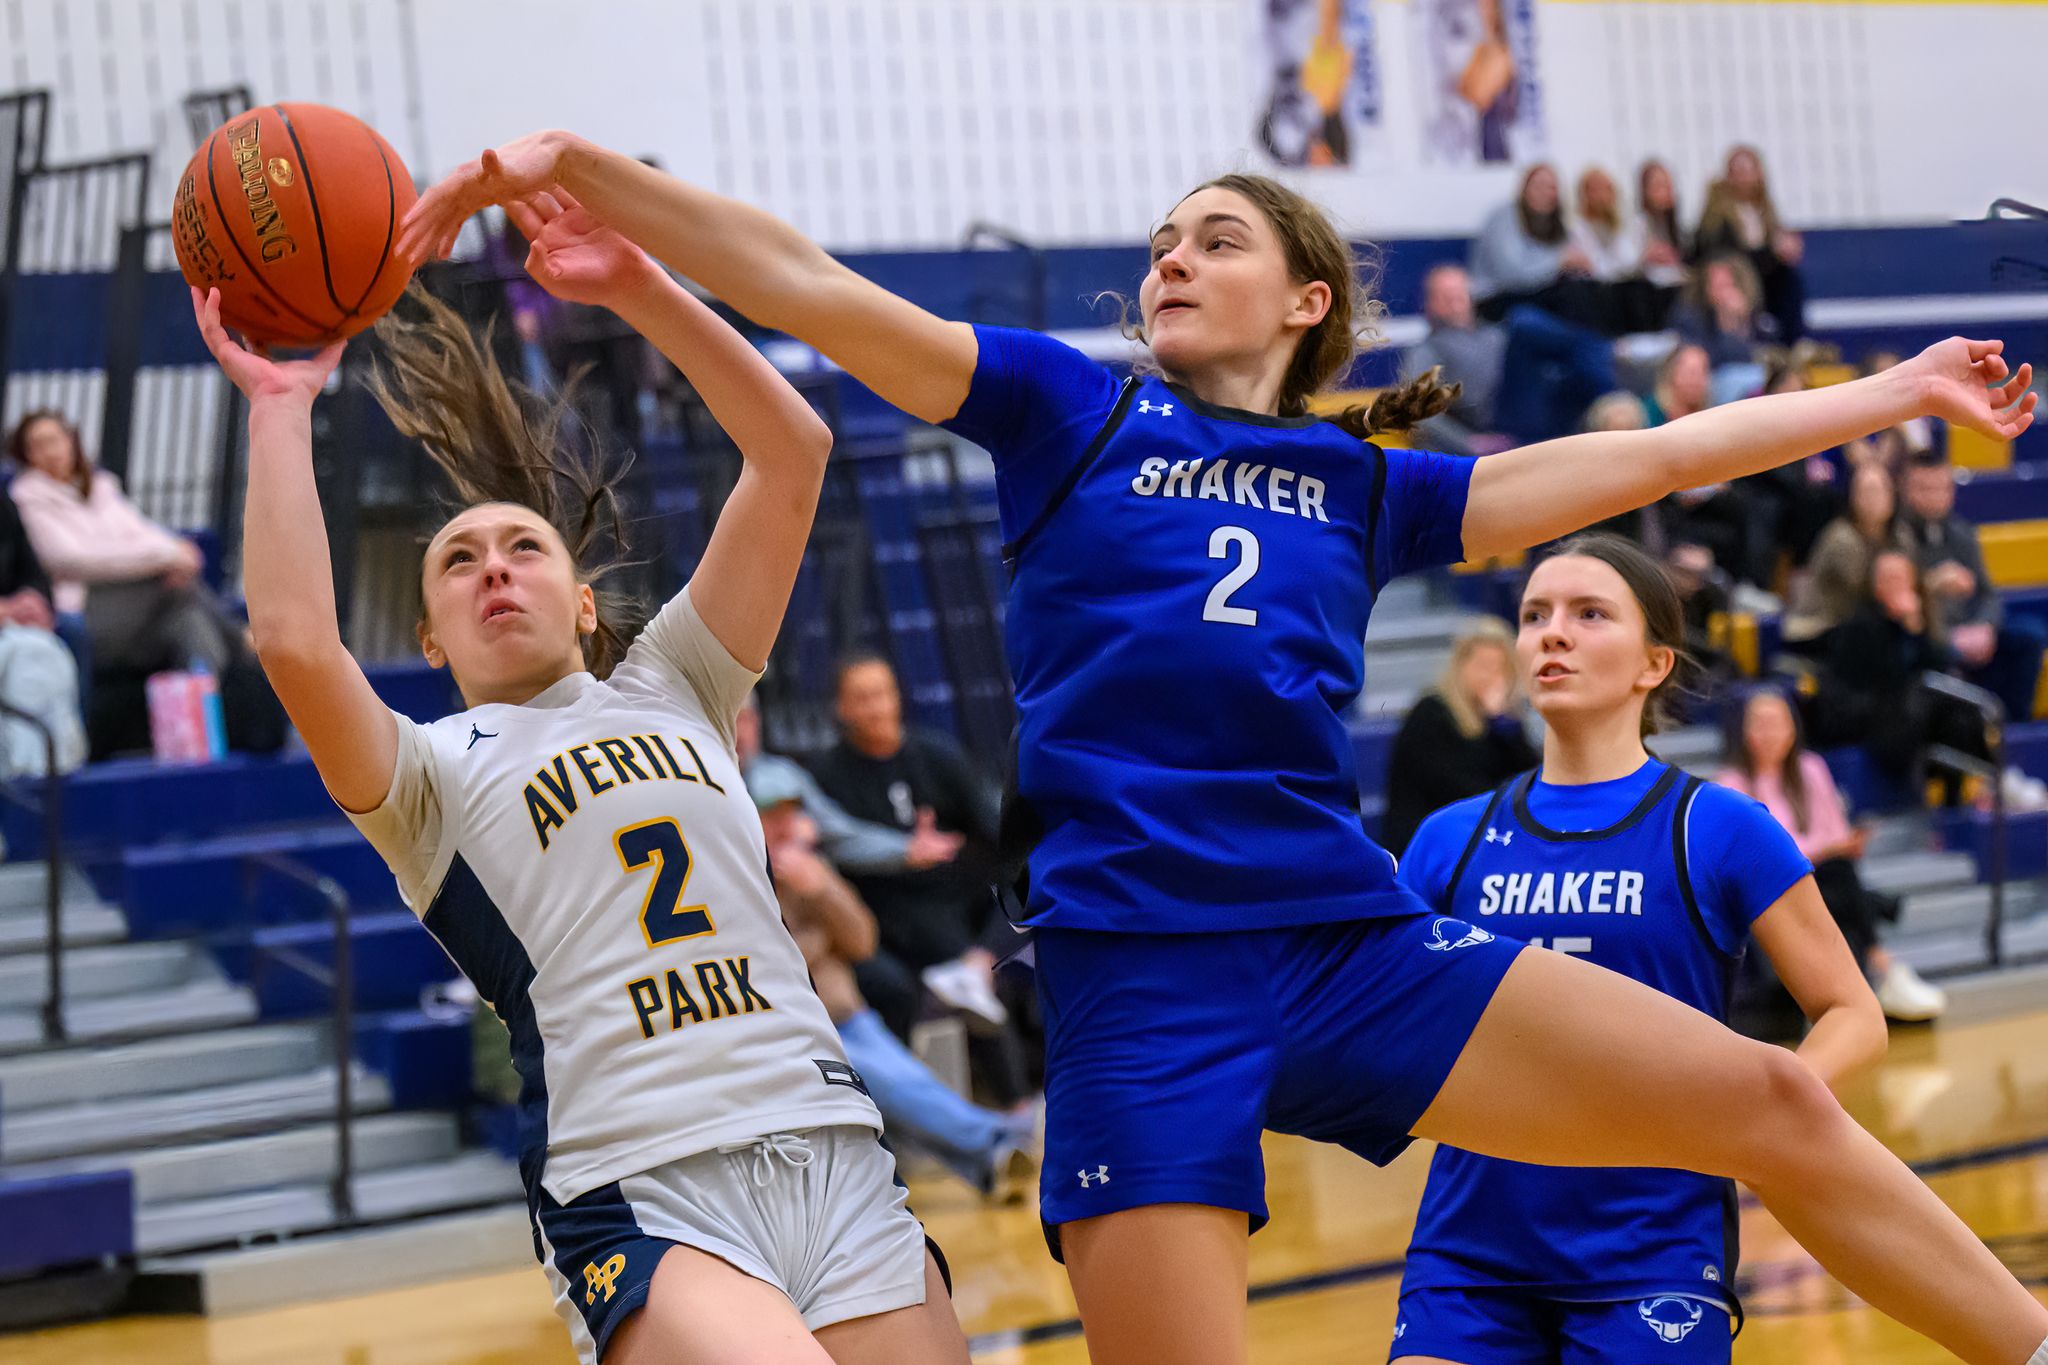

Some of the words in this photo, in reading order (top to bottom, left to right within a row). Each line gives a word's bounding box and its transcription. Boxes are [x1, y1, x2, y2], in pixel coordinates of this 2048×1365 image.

[1131, 456, 1330, 523] SHAKER
[1203, 525, 1260, 626] 2
[523, 734, 726, 853] AVERILL
[612, 816, 717, 949] 2
[1478, 870, 1644, 915] SHAKER
[626, 956, 774, 1039] PARK
[583, 1253, 626, 1306] AP
